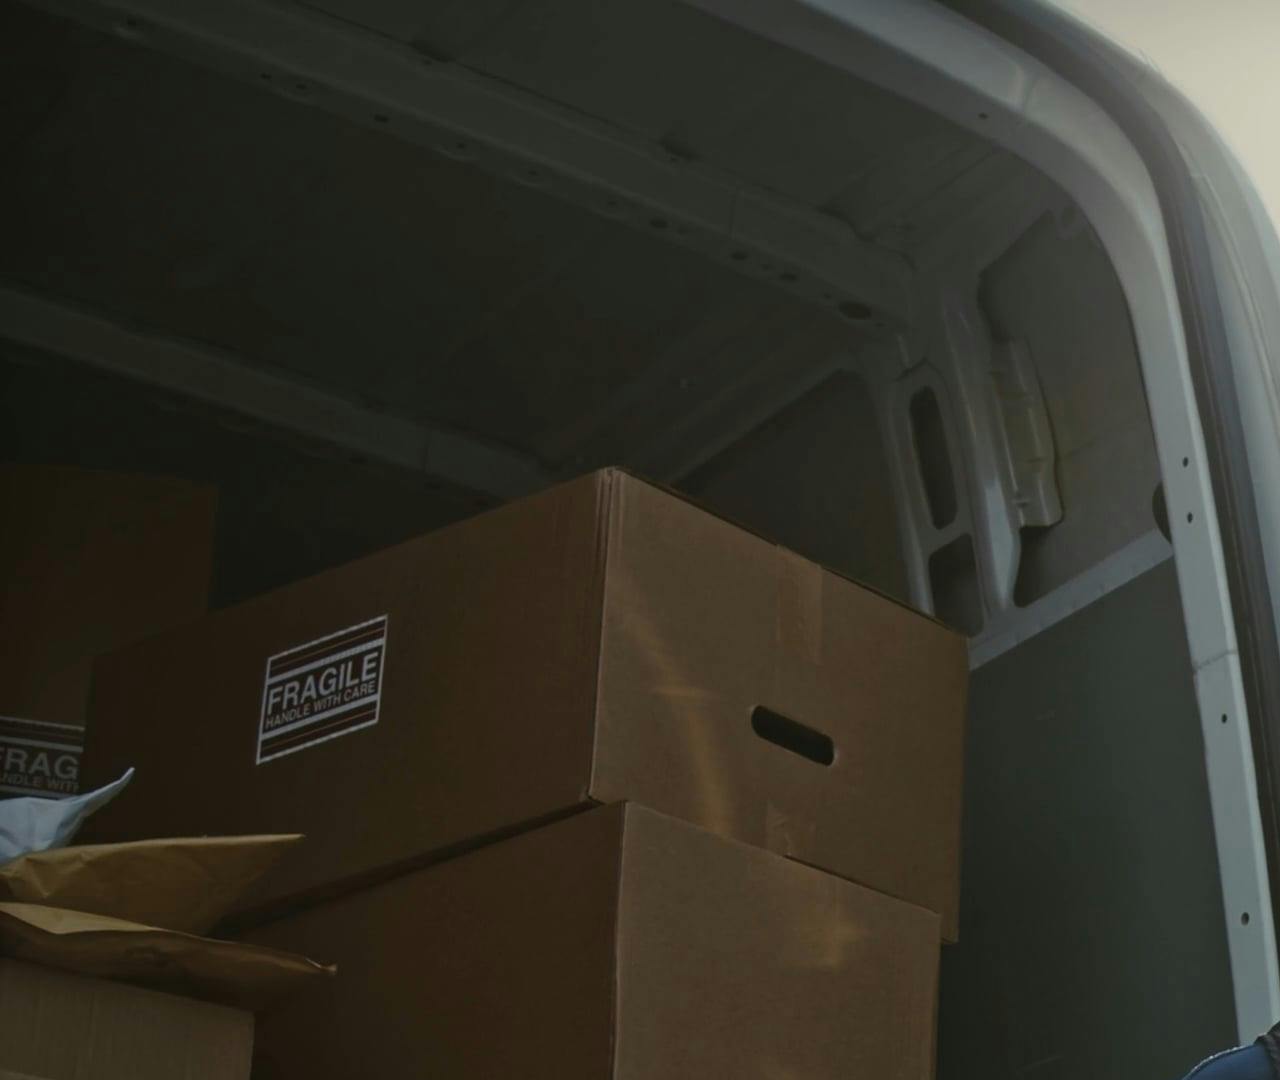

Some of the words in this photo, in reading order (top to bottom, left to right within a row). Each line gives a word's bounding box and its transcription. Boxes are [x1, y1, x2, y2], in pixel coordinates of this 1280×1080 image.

[267, 652, 379, 715] FRAGILE
[265, 702, 312, 729] HANDLE
[313, 694, 341, 712] WITH
[344, 680, 376, 700] CARE
[0, 747, 79, 780] RAG
[0, 772, 41, 788] NDLE
